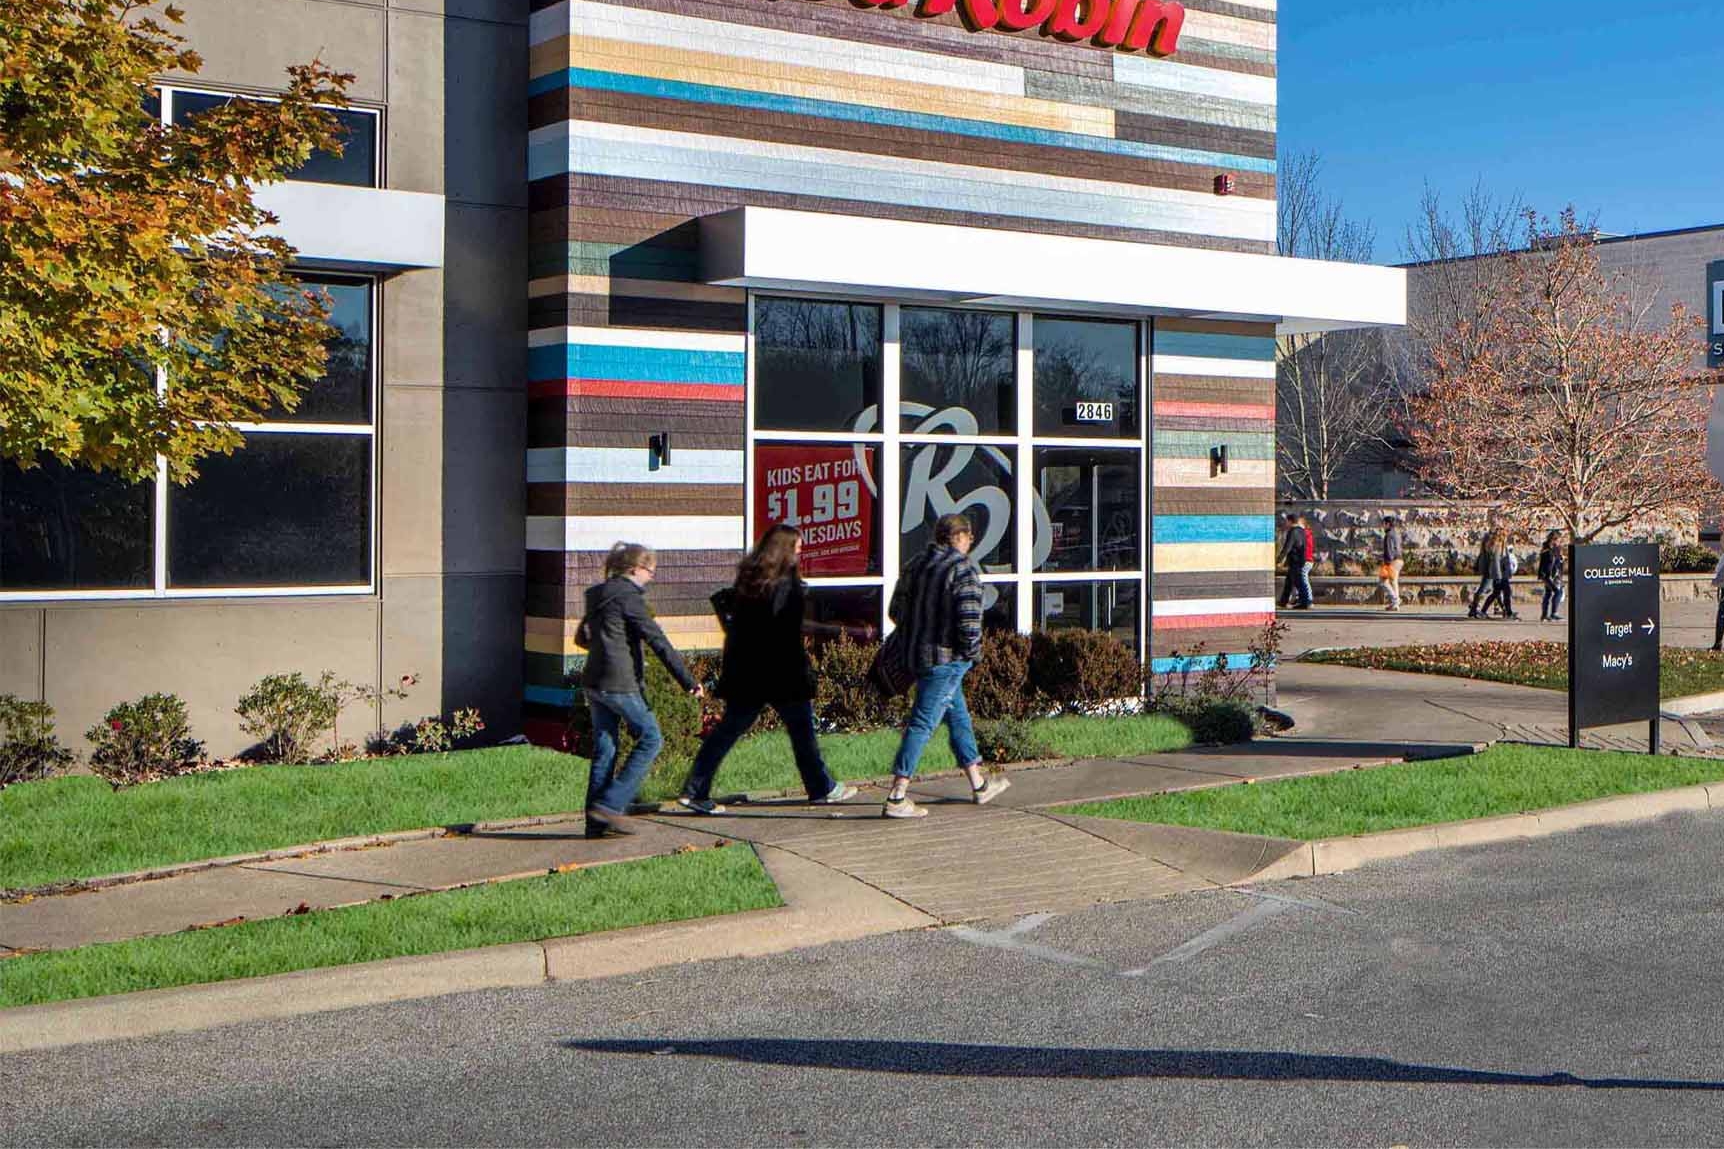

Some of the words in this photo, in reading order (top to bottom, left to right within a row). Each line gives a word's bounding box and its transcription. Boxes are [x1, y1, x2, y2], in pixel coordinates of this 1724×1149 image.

[1077, 403, 1112, 420] 2846
[767, 466, 801, 488] KIDS
[804, 462, 831, 482] EAT
[767, 480, 859, 527] $1.99
[800, 520, 862, 545] NESDAYS
[1584, 567, 1627, 579] COLLEGE
[1628, 566, 1653, 577] MALL
[1604, 622, 1633, 637] Target
[1602, 653, 1633, 669] Macy's
